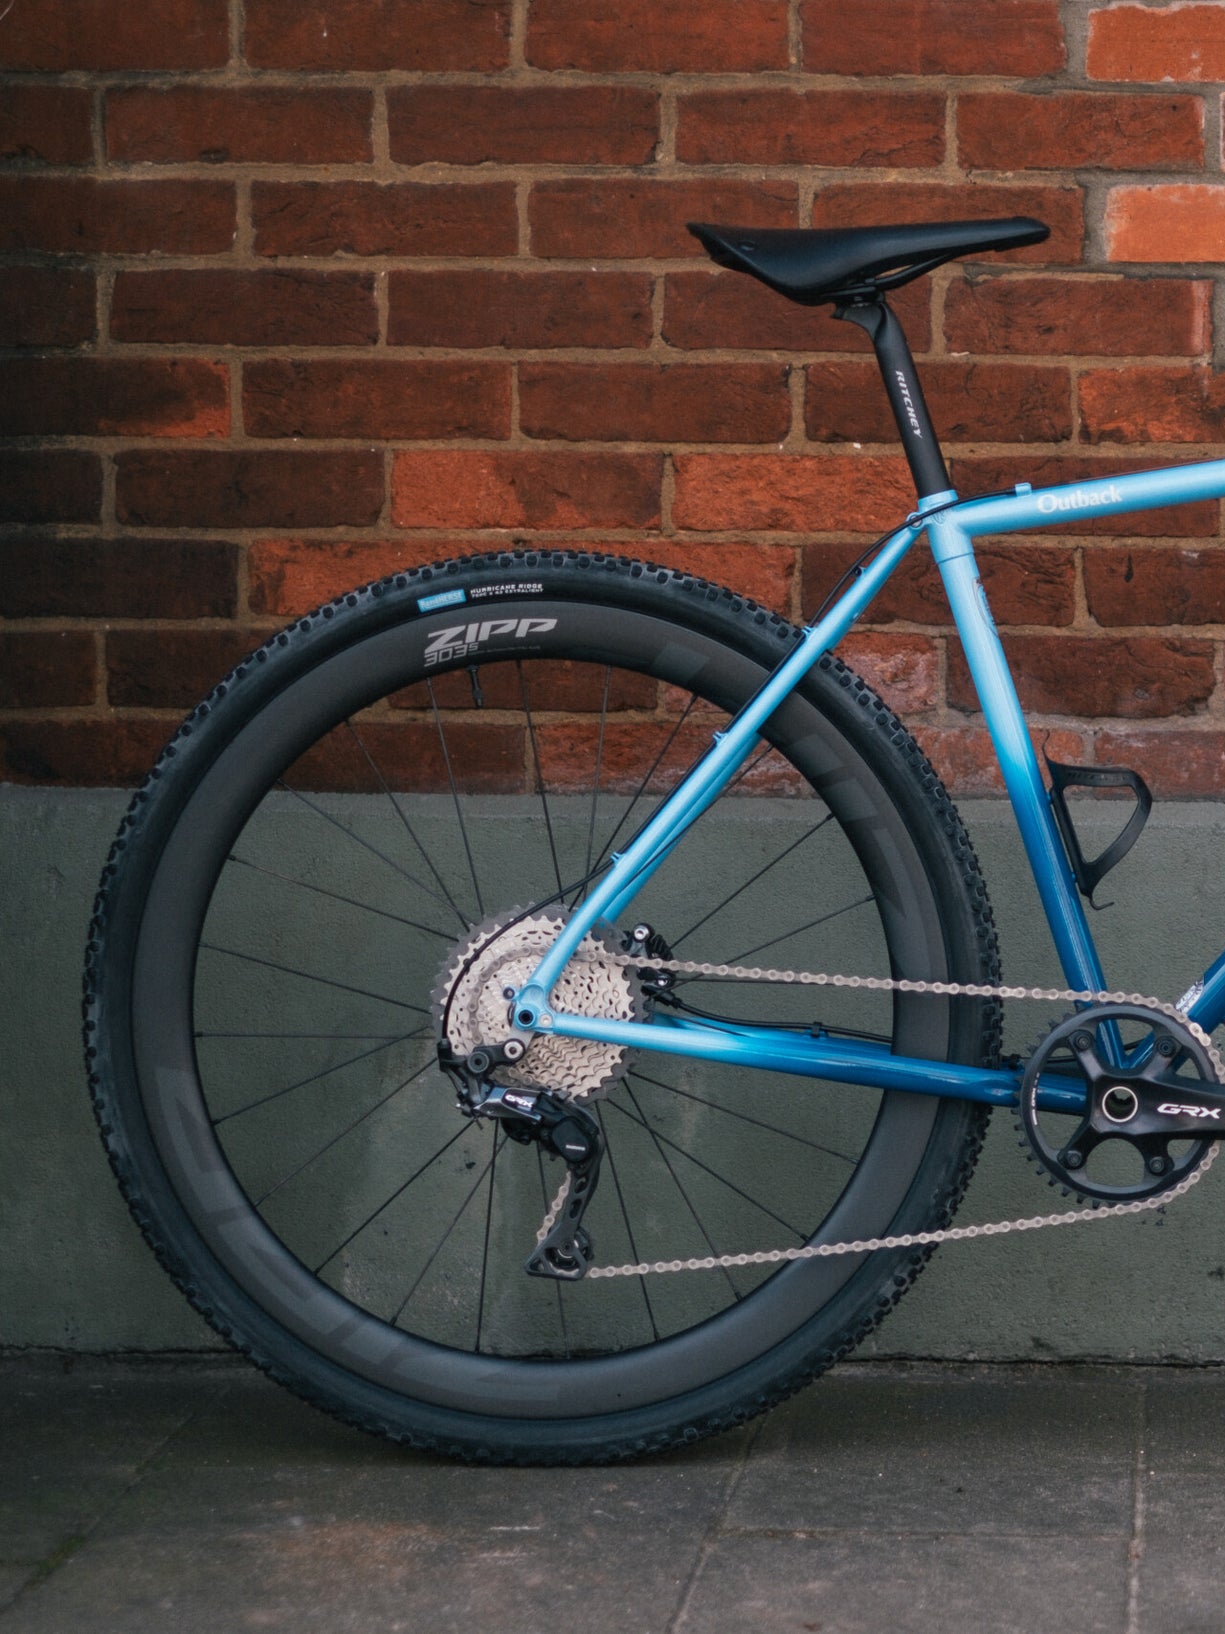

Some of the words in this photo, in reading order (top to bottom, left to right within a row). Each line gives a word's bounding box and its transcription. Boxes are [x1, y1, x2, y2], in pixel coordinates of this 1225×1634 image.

[895, 370, 923, 439] RITCHEY
[1038, 484, 1122, 513] Outback
[470, 584, 517, 595] HURRICANE
[424, 618, 558, 654] ZIPP
[1156, 1103, 1221, 1120] GRX
